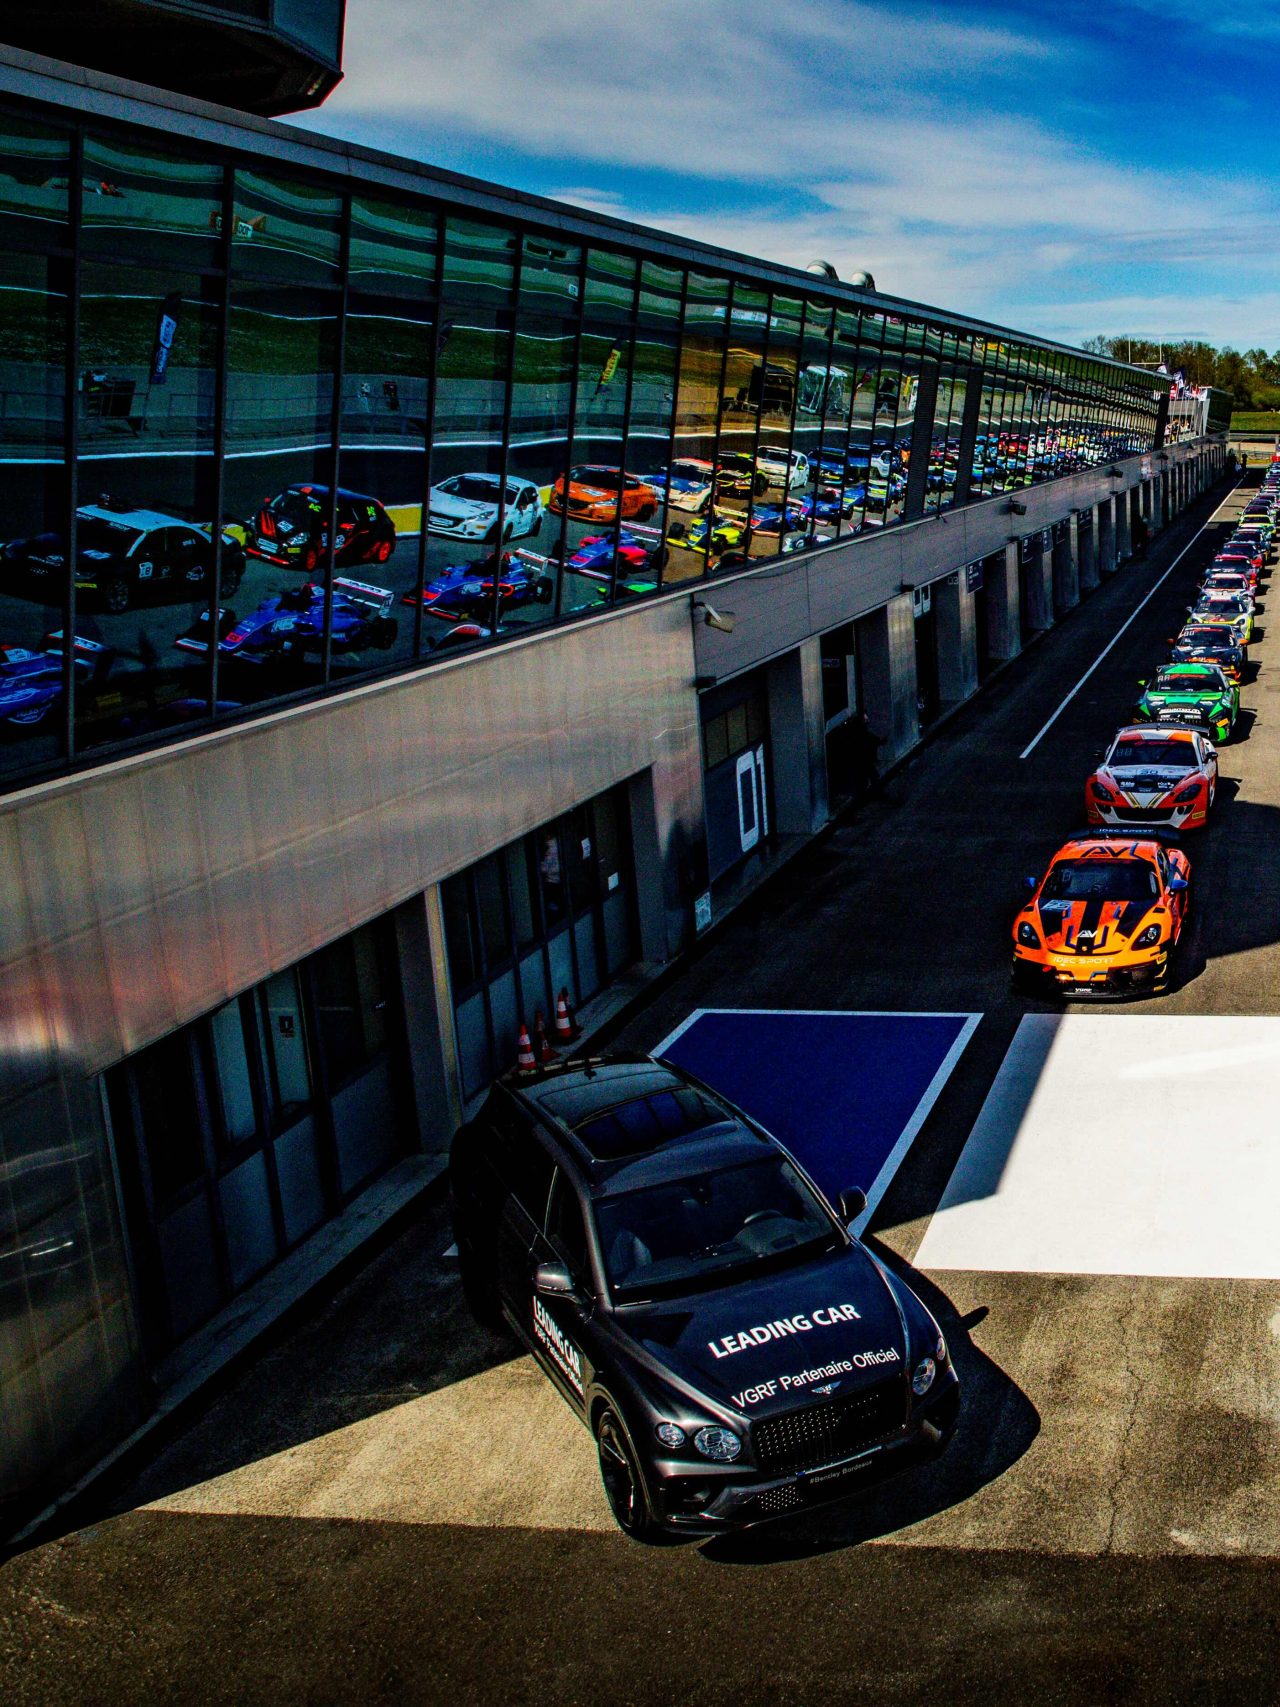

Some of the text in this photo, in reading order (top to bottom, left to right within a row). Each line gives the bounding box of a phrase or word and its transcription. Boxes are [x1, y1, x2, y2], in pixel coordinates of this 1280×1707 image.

[736, 742, 768, 853] 01
[533, 1295, 581, 1378] LEADING CAR
[708, 1303, 861, 1359] LEADING CAR
[732, 1347, 900, 1408] VGRF Partenaire Officiel
